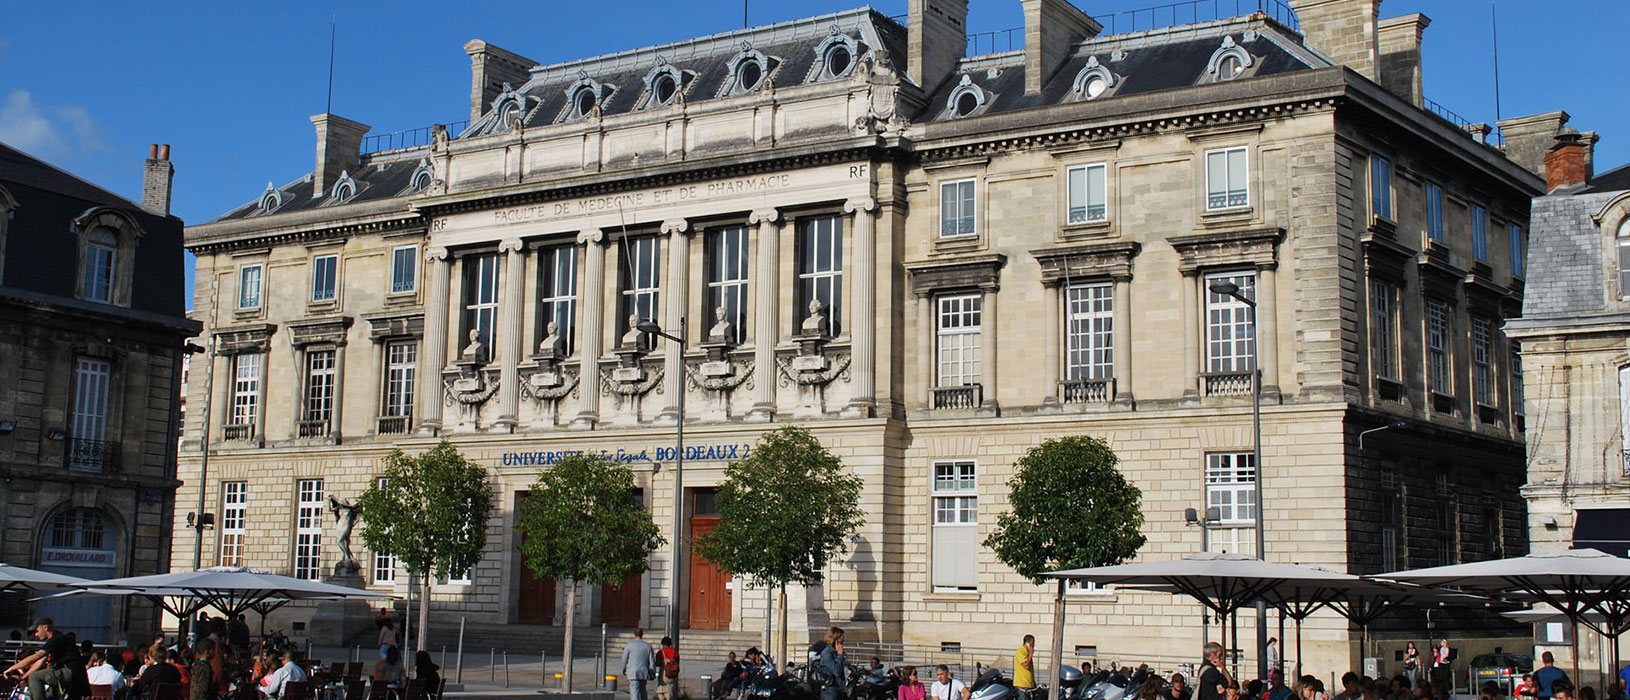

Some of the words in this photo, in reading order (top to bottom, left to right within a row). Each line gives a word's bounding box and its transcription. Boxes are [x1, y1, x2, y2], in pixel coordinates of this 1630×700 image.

[849, 165, 868, 178] RF
[494, 206, 544, 223] FACULTE
[554, 202, 570, 215] DE
[654, 189, 673, 203] ET
[680, 186, 697, 199] DE
[707, 174, 790, 196] PHARMACIE
[434, 219, 448, 231] RF
[656, 444, 738, 461] BORDEAUX
[743, 443, 751, 458] 2
